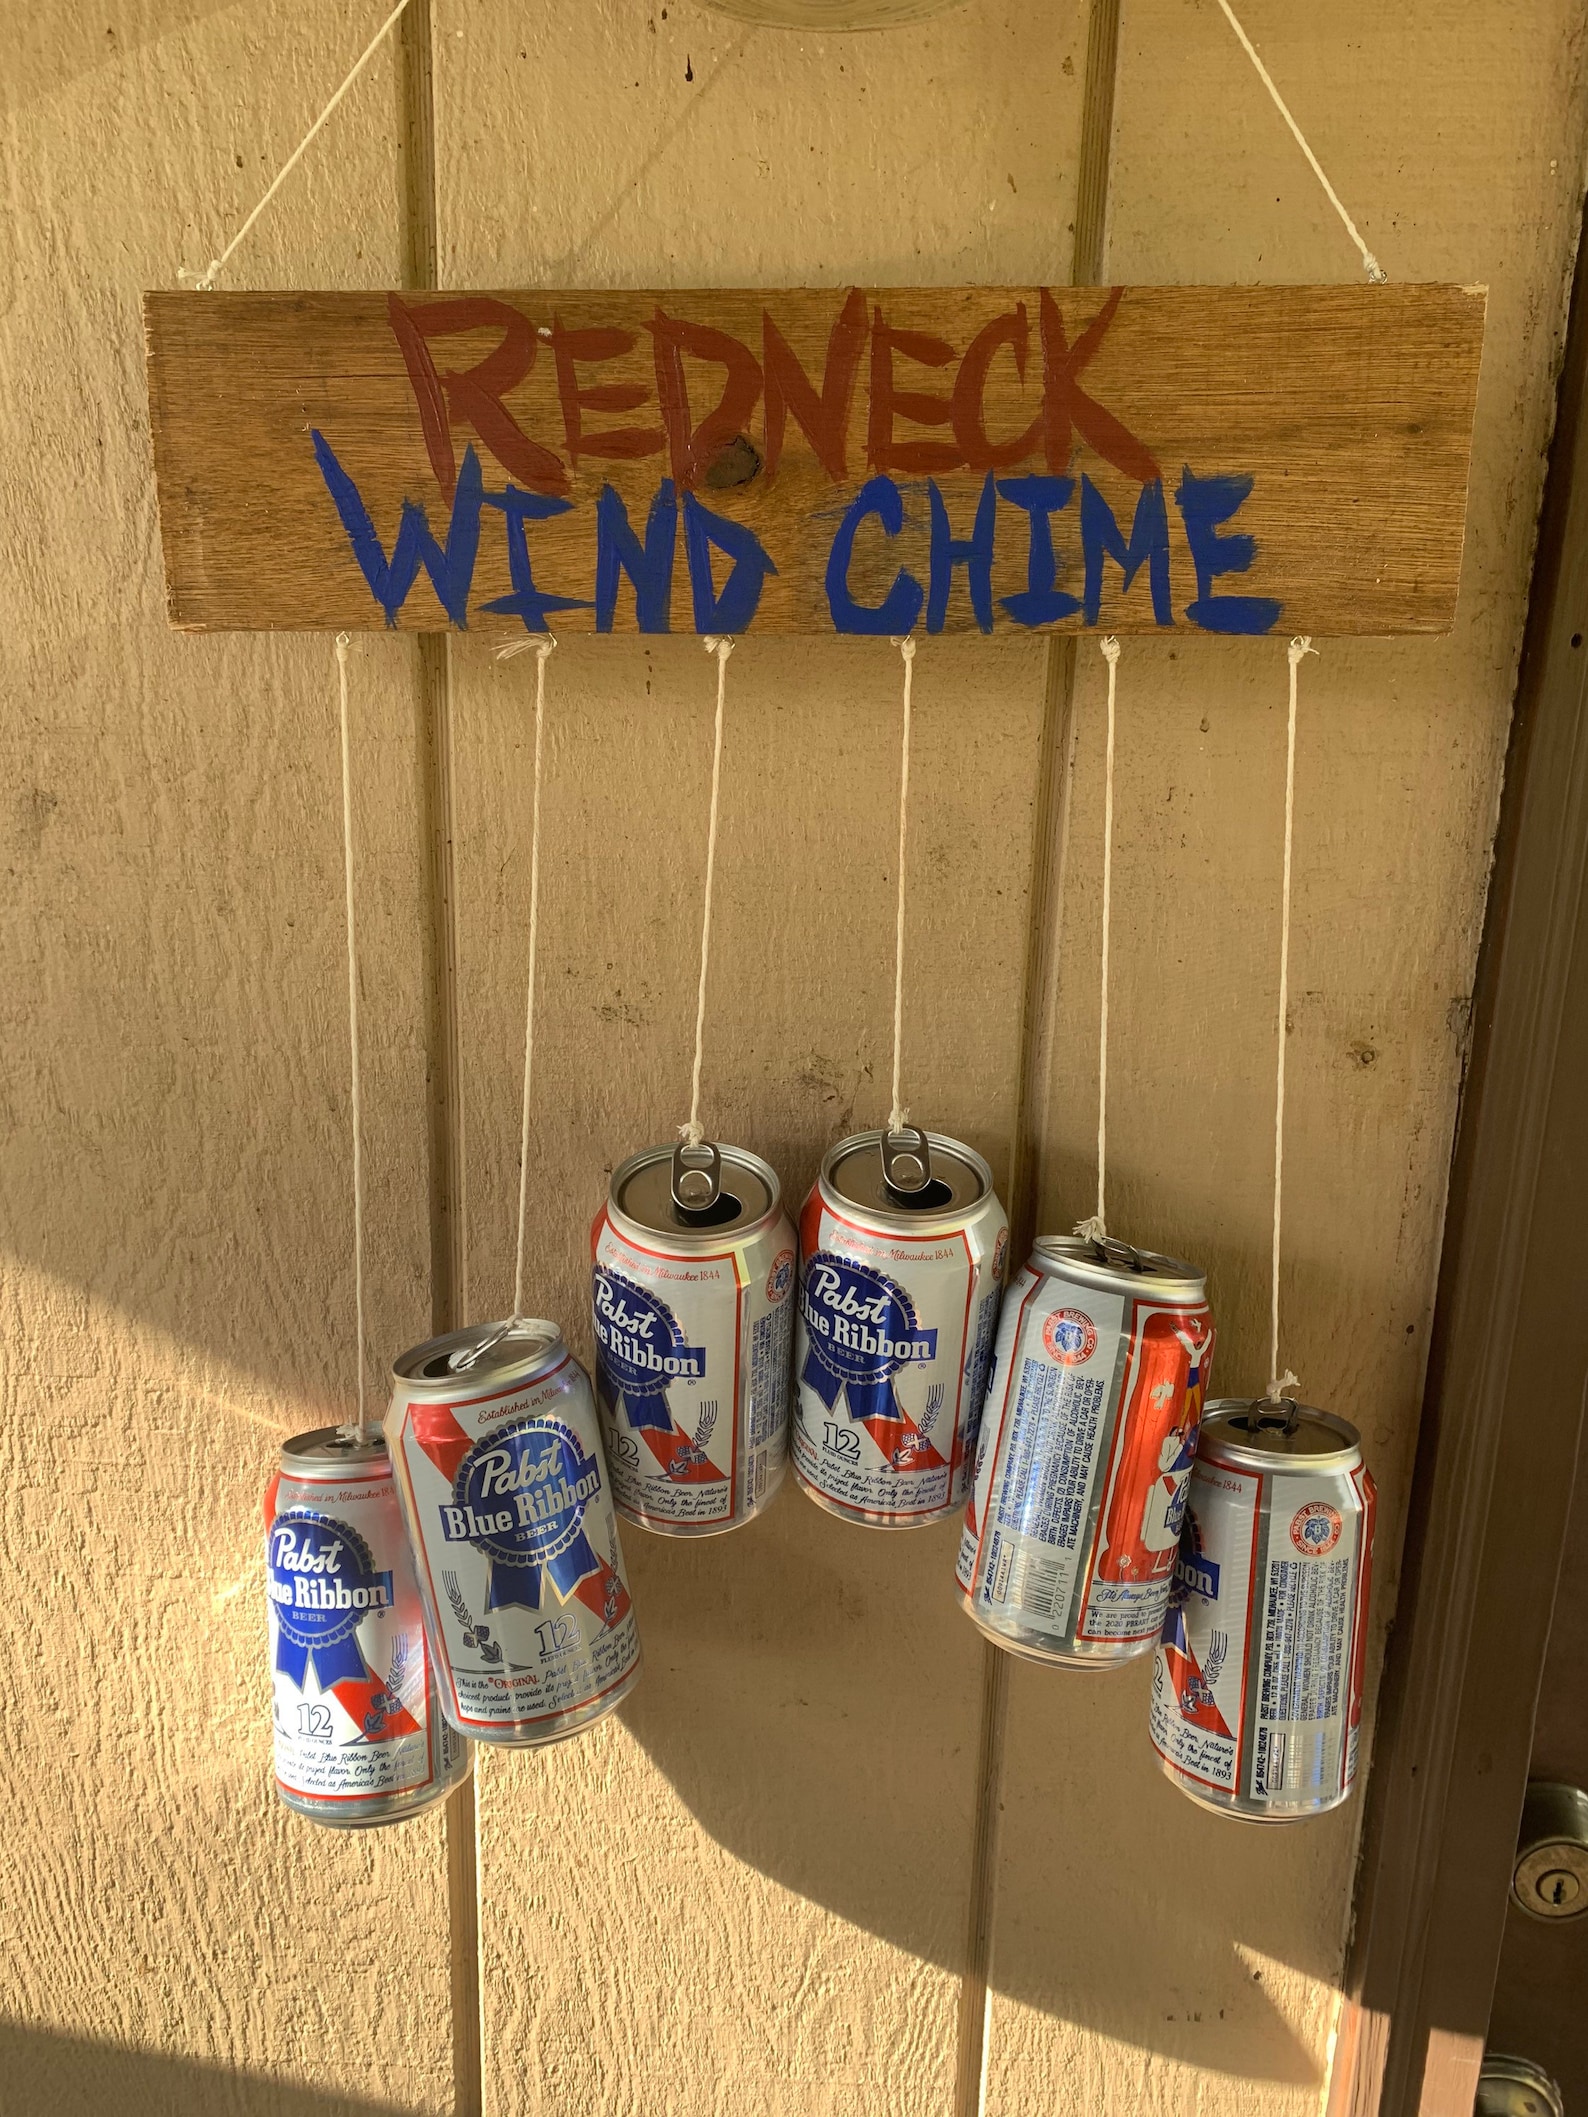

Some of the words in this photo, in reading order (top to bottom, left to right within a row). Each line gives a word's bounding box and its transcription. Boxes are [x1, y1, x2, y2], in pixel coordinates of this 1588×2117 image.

[389, 286, 1160, 497] REDNECK
[311, 428, 778, 634] WIND
[825, 470, 1284, 635] CHIME
[886, 1249, 933, 1261] Milwaukee
[935, 1248, 954, 1260] 1844
[650, 1266, 698, 1281] Milwaukee
[815, 1263, 891, 1324] Pabst
[596, 1274, 657, 1339] Pabst
[1046, 1312, 1061, 1335] PABST
[1064, 1311, 1093, 1335] BREWING
[832, 1314, 931, 1359] Ribbon
[610, 1324, 700, 1376] Ribbon
[827, 1342, 865, 1364] BEER
[607, 1353, 638, 1376] BEER
[1085, 1376, 1096, 1396] OPER-
[1091, 1378, 1105, 1414] PROBLEMS.
[478, 1400, 529, 1424] Established
[1055, 1421, 1068, 1451] BECAUSE
[1076, 1426, 1087, 1445] DRIVE
[1087, 1416, 1098, 1440] HEALTH
[609, 1427, 640, 1467] 12
[823, 1422, 860, 1459] 12
[1082, 1442, 1094, 1463] CAUSE
[473, 1439, 562, 1498] Pabst
[837, 1455, 859, 1466] OUNCES
[1048, 1525, 1059, 1544] BIRTH
[1058, 1439, 1074, 1485] CONSUMPTION
[1069, 1391, 1083, 1426] ALCOHOLIC
[1048, 1452, 1062, 1490] PREGNANCY
[1070, 1455, 1082, 1479] ABILITY
[1079, 1464, 1090, 1479] MAY
[819, 1459, 840, 1473] Pabst
[861, 1476, 892, 1487] Ribbon
[915, 1472, 947, 1489] Nature's
[828, 1473, 848, 1487] prized
[915, 1485, 937, 1497] finest
[334, 1491, 380, 1503] Milwaukee
[644, 1482, 670, 1495] Ribbon
[693, 1485, 728, 1500] Nature's
[819, 1480, 849, 1499] Selected
[857, 1495, 895, 1507] America's
[895, 1497, 916, 1508] Best
[1066, 1478, 1077, 1496] YOUR
[1076, 1481, 1087, 1496] AND
[1222, 1480, 1242, 1493] 1844
[444, 1506, 513, 1539] Blue
[514, 1470, 600, 1527] Ribbon
[643, 1500, 675, 1515] America's
[1043, 1491, 1055, 1516] DURING
[1062, 1496, 1074, 1522] IMPAIRS
[1069, 1497, 1085, 1536] MACHINERY,
[1293, 1510, 1308, 1534] PABST
[516, 1521, 558, 1542] BEER
[1039, 1516, 1051, 1542] ERAGES
[1057, 1523, 1069, 1547] ERAGES
[275, 1527, 344, 1574] Pabst
[294, 1576, 389, 1610] Ribbon
[292, 1611, 327, 1622] BEER
[534, 1613, 581, 1657] 12
[456, 1677, 470, 1688] This
[494, 1674, 539, 1690] ORIGINAL
[297, 1703, 333, 1737] 12
[340, 1752, 367, 1765] Ribbon
[1198, 1740, 1234, 1756] Nature's
[1199, 1750, 1220, 1764] finest
[355, 1765, 375, 1777] Only
[1182, 1755, 1200, 1768] Best
[1212, 1767, 1231, 1780] 1893
